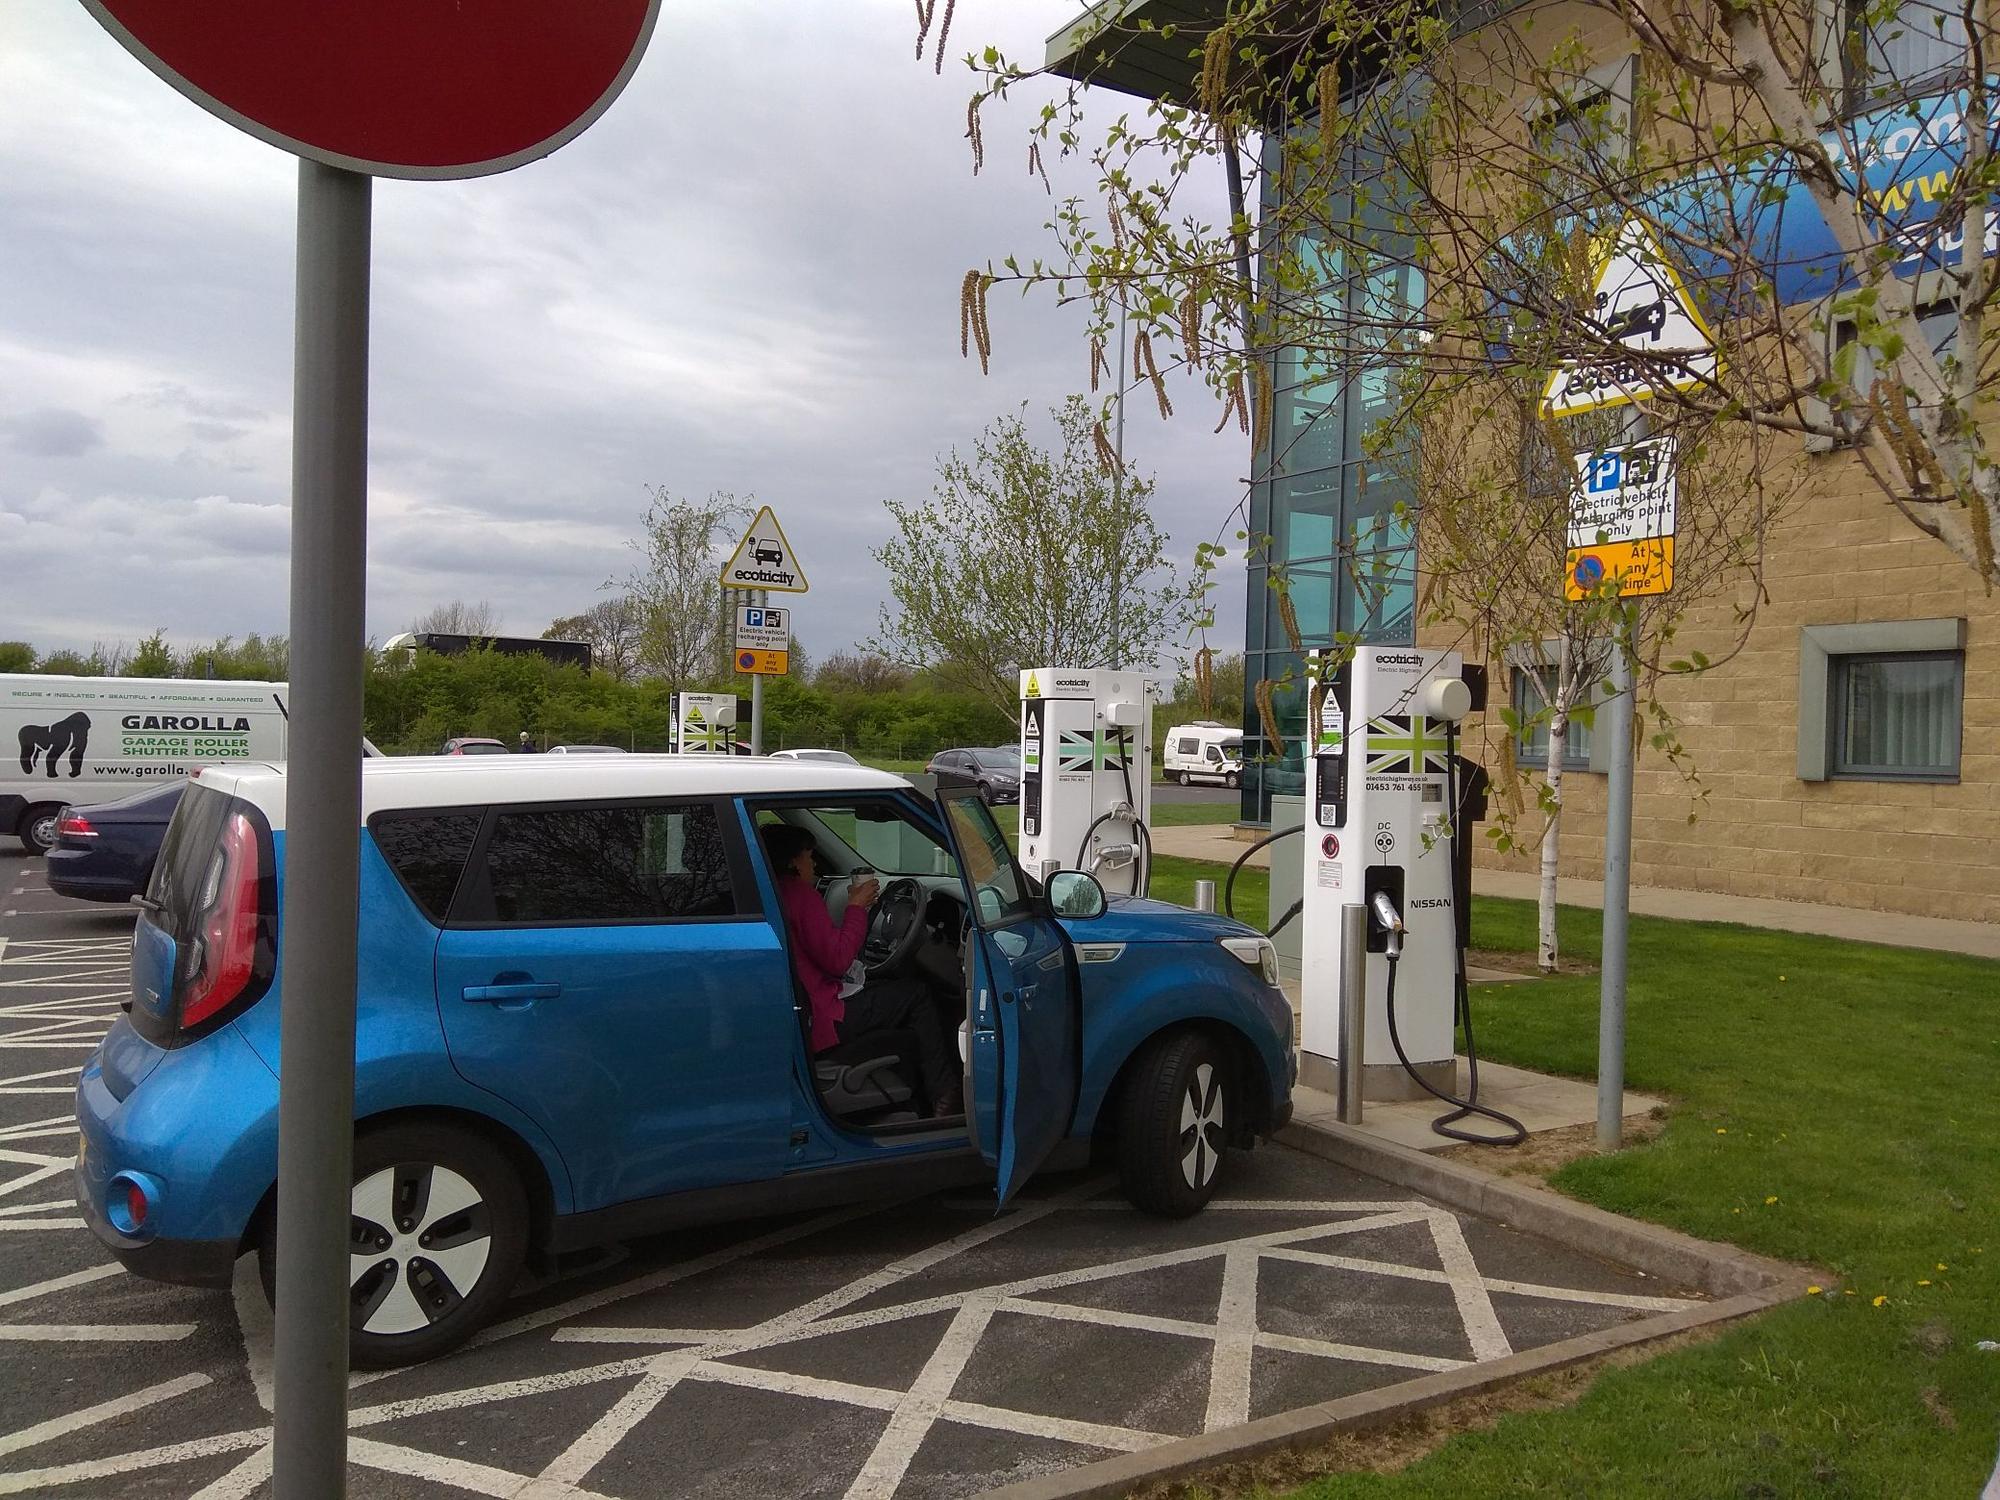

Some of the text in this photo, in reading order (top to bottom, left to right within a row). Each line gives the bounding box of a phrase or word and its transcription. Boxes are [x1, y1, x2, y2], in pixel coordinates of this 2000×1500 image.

[1596, 458, 1616, 488] P
[1606, 522, 1632, 536] only
[1631, 546, 1646, 558] At
[1627, 563, 1649, 576] any
[735, 569, 795, 587] ecotricity
[1624, 578, 1651, 590] time
[750, 611, 761, 625] P
[739, 626, 786, 636] Electric vehicle
[737, 634, 770, 642] recharging
[1375, 654, 1425, 667] ecotricity
[1056, 679, 1090, 688] ecotricity
[121, 715, 251, 731] GAROLLA
[122, 737, 249, 748] GARAGE ROLLER
[122, 747, 250, 757] SHUTTER DOORS
[94, 764, 189, 777] www.garolla.
[1365, 783, 1390, 791] 01453
[1392, 784, 1405, 792] 761
[1408, 784, 1422, 792] 455
[1378, 822, 1391, 830] DC
[1410, 898, 1451, 908] NISSAN
